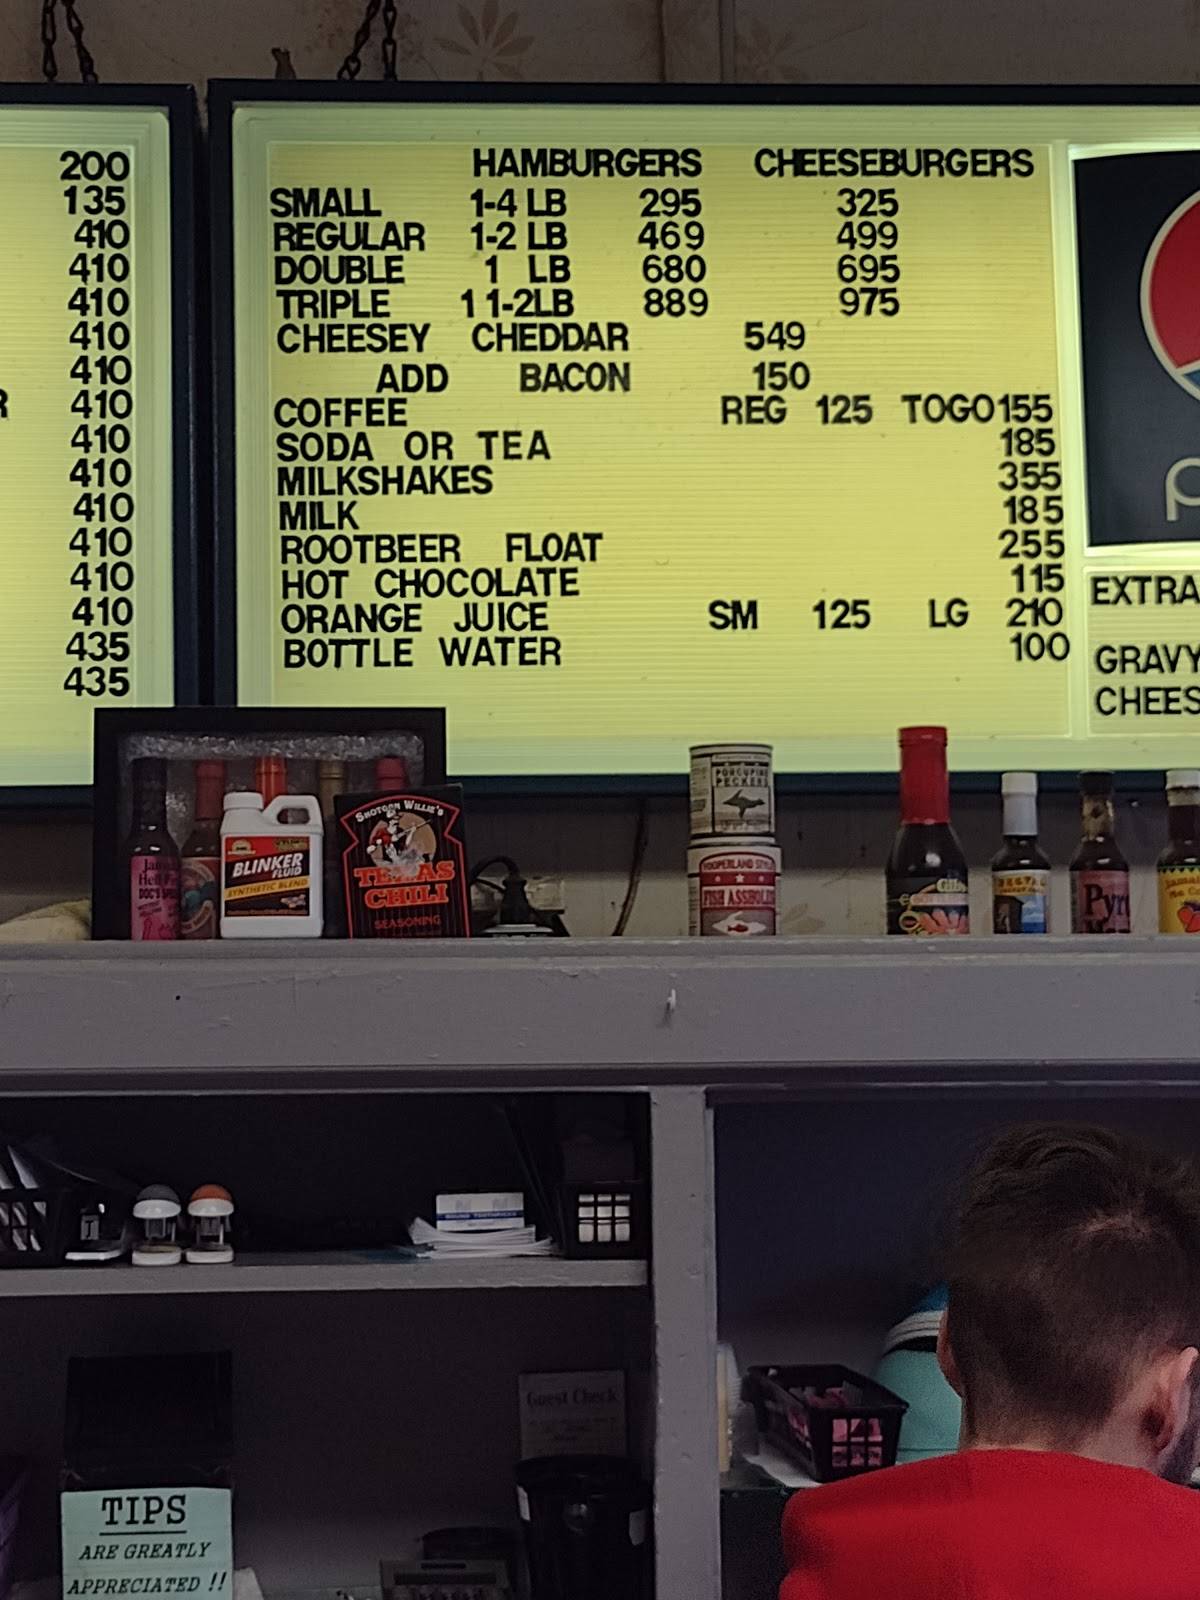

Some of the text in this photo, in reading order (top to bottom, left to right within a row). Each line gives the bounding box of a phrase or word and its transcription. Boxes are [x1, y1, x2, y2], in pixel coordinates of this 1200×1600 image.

[59, 150, 131, 182] 200
[472, 147, 1035, 178] HAMBURGERS CHEESEBURGERS
[63, 184, 126, 217] 135
[269, 187, 899, 219] SMALL 1-4 LB 295 325
[74, 219, 131, 250] 410
[273, 220, 899, 253] REGULAR 1-2 LB 469 499
[68, 252, 130, 285] 410
[274, 253, 901, 286] DOUBLE 1 LB 680 695
[67, 286, 130, 318] 410
[275, 288, 391, 320] TRIPLE
[643, 287, 709, 318] 889
[839, 287, 900, 317] 975
[69, 320, 131, 351] 410
[276, 321, 806, 354] CHEESEY CHEDDAR 549
[70, 354, 132, 386] 410
[375, 361, 811, 394] ADD BACON 150
[70, 389, 133, 420] 410
[273, 397, 408, 429] COFFEE
[721, 394, 787, 425] REG
[816, 394, 873, 425] 125
[70, 423, 131, 454] 410
[275, 427, 1056, 463] SODA OR TEA 185
[69, 457, 132, 488] 410
[277, 461, 1062, 497] MILKSHAKES 355
[73, 492, 135, 523] 410
[279, 495, 1064, 532] MILK 185
[69, 526, 133, 558] 410
[280, 529, 1065, 565] ROOTBEER FLOAT 255
[70, 560, 134, 592] 410
[281, 563, 1065, 600] HOT CHOCOLATE 115
[1090, 574, 1200, 605] EXTRA
[72, 596, 134, 627] 410
[280, 597, 1063, 634] ORANGE JUICE SM 125 LG 210
[65, 631, 131, 662] 435
[283, 631, 1071, 669] BOTTLE WATER 100
[1095, 644, 1200, 675] GRAVY
[63, 665, 130, 697] 435
[1095, 685, 1200, 716] CHEES
[232, 852, 304, 878] BLINKER
[271, 866, 303, 879] FLUID
[353, 859, 456, 888] TEAS
[227, 878, 309, 898] SYNTHETIC BLEND
[364, 882, 450, 910] CHILI
[100, 1494, 187, 1526] TIPS
[78, 1541, 212, 1561] ARE GREATLY
[66, 1576, 200, 1595] APPRECIATED
